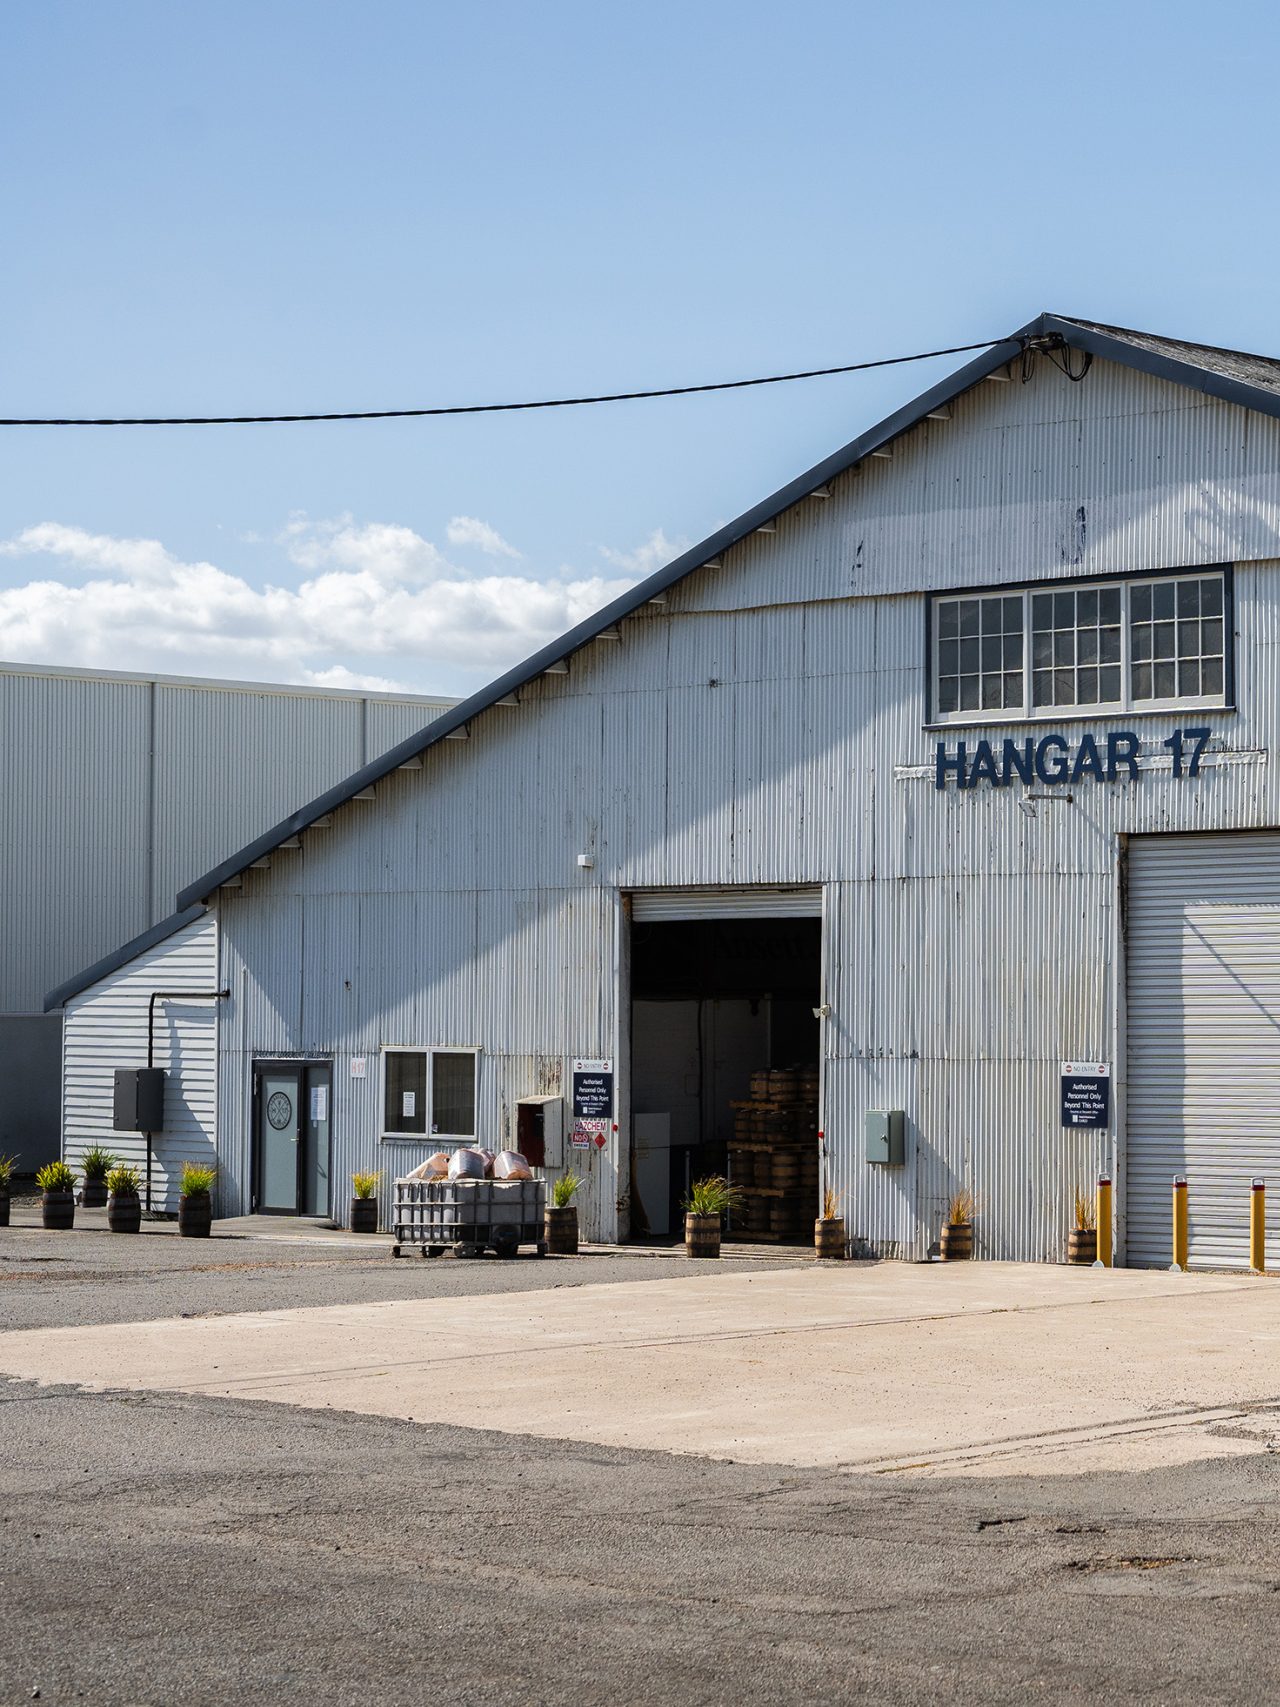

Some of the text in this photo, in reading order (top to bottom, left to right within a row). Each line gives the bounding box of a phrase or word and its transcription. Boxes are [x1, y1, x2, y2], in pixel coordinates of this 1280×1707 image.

[935, 727, 1211, 790] HANGAR 17
[1064, 1102, 1080, 1110] Beyond
[574, 1122, 606, 1131] HAZCHEM
